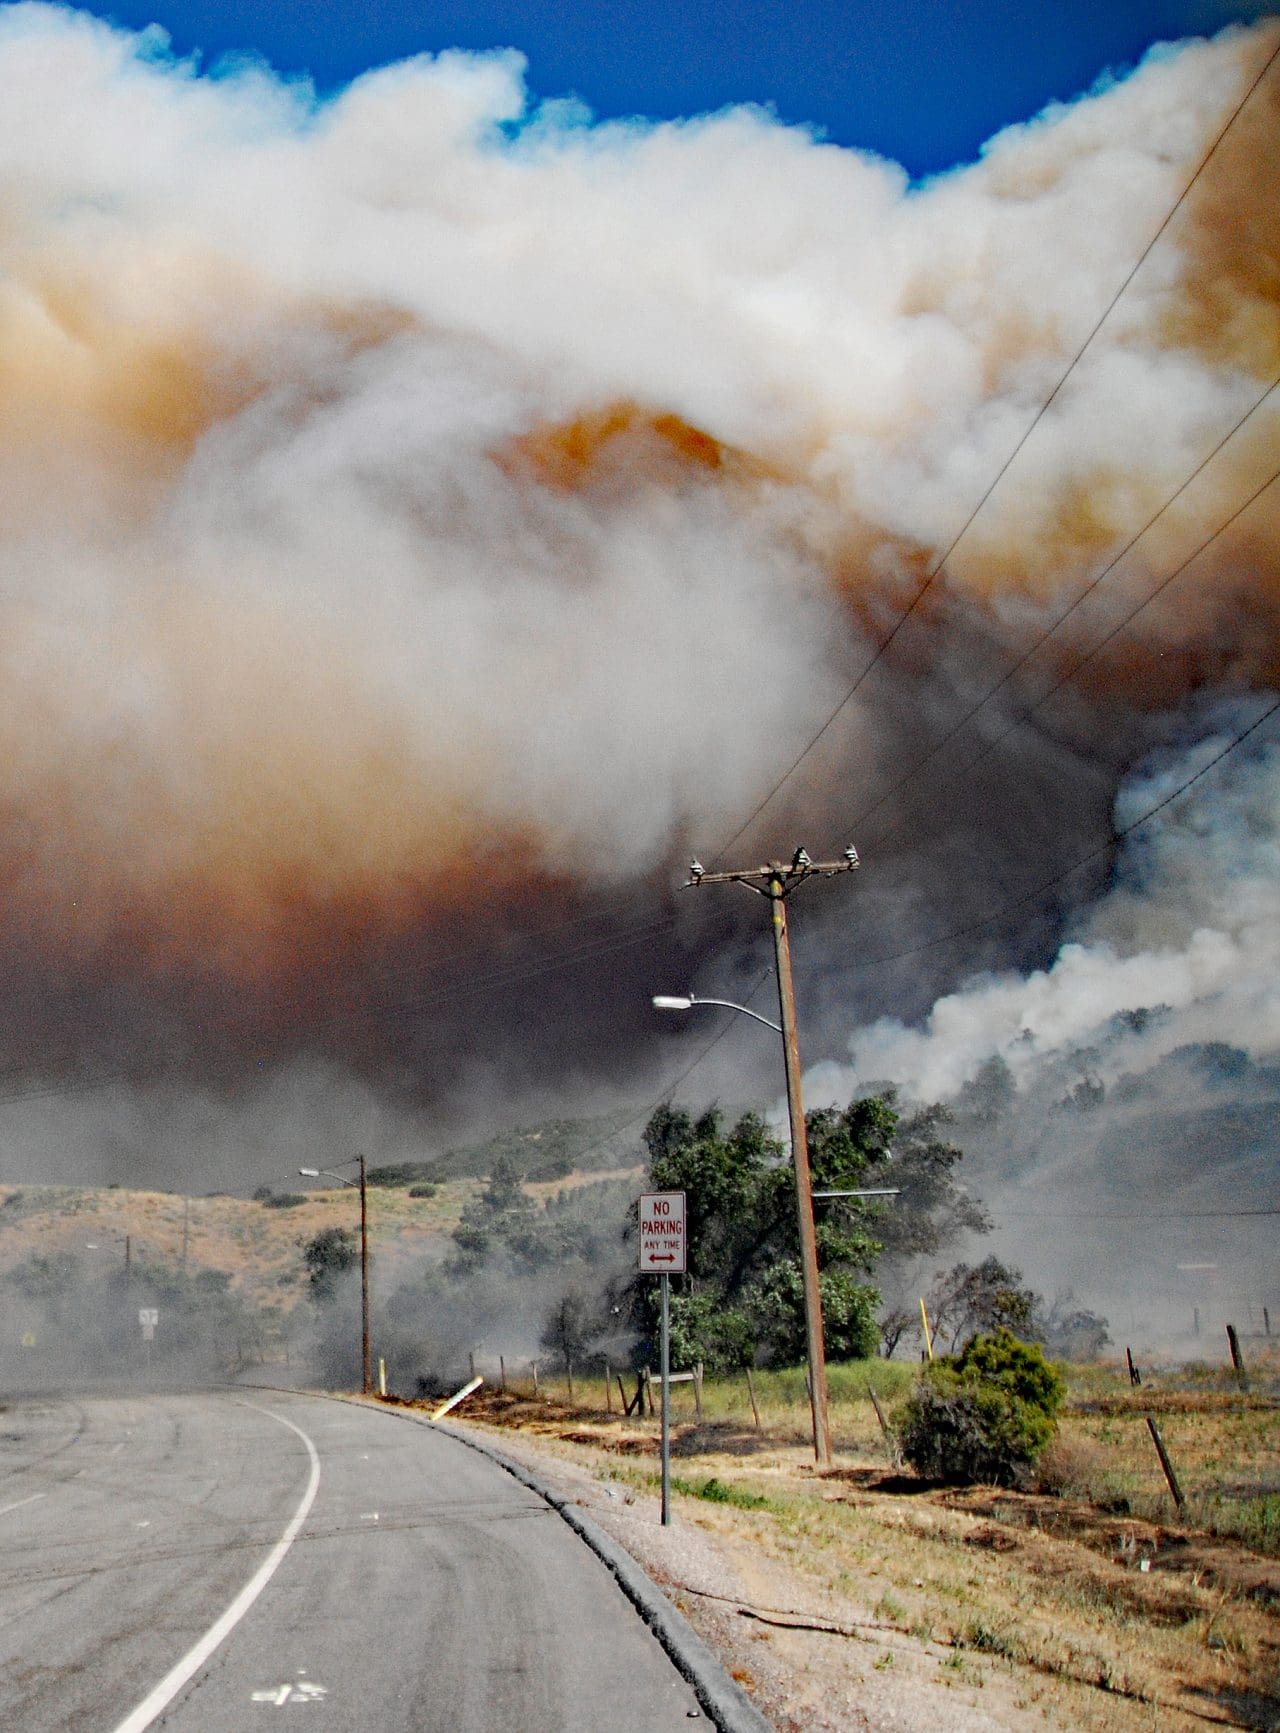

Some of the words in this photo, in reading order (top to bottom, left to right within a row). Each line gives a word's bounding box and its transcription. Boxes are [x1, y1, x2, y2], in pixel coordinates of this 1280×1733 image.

[653, 1201, 669, 1215] NO
[642, 1221, 682, 1234] PARKING
[645, 1241, 660, 1249] ANY
[664, 1241, 680, 1249] TIME
